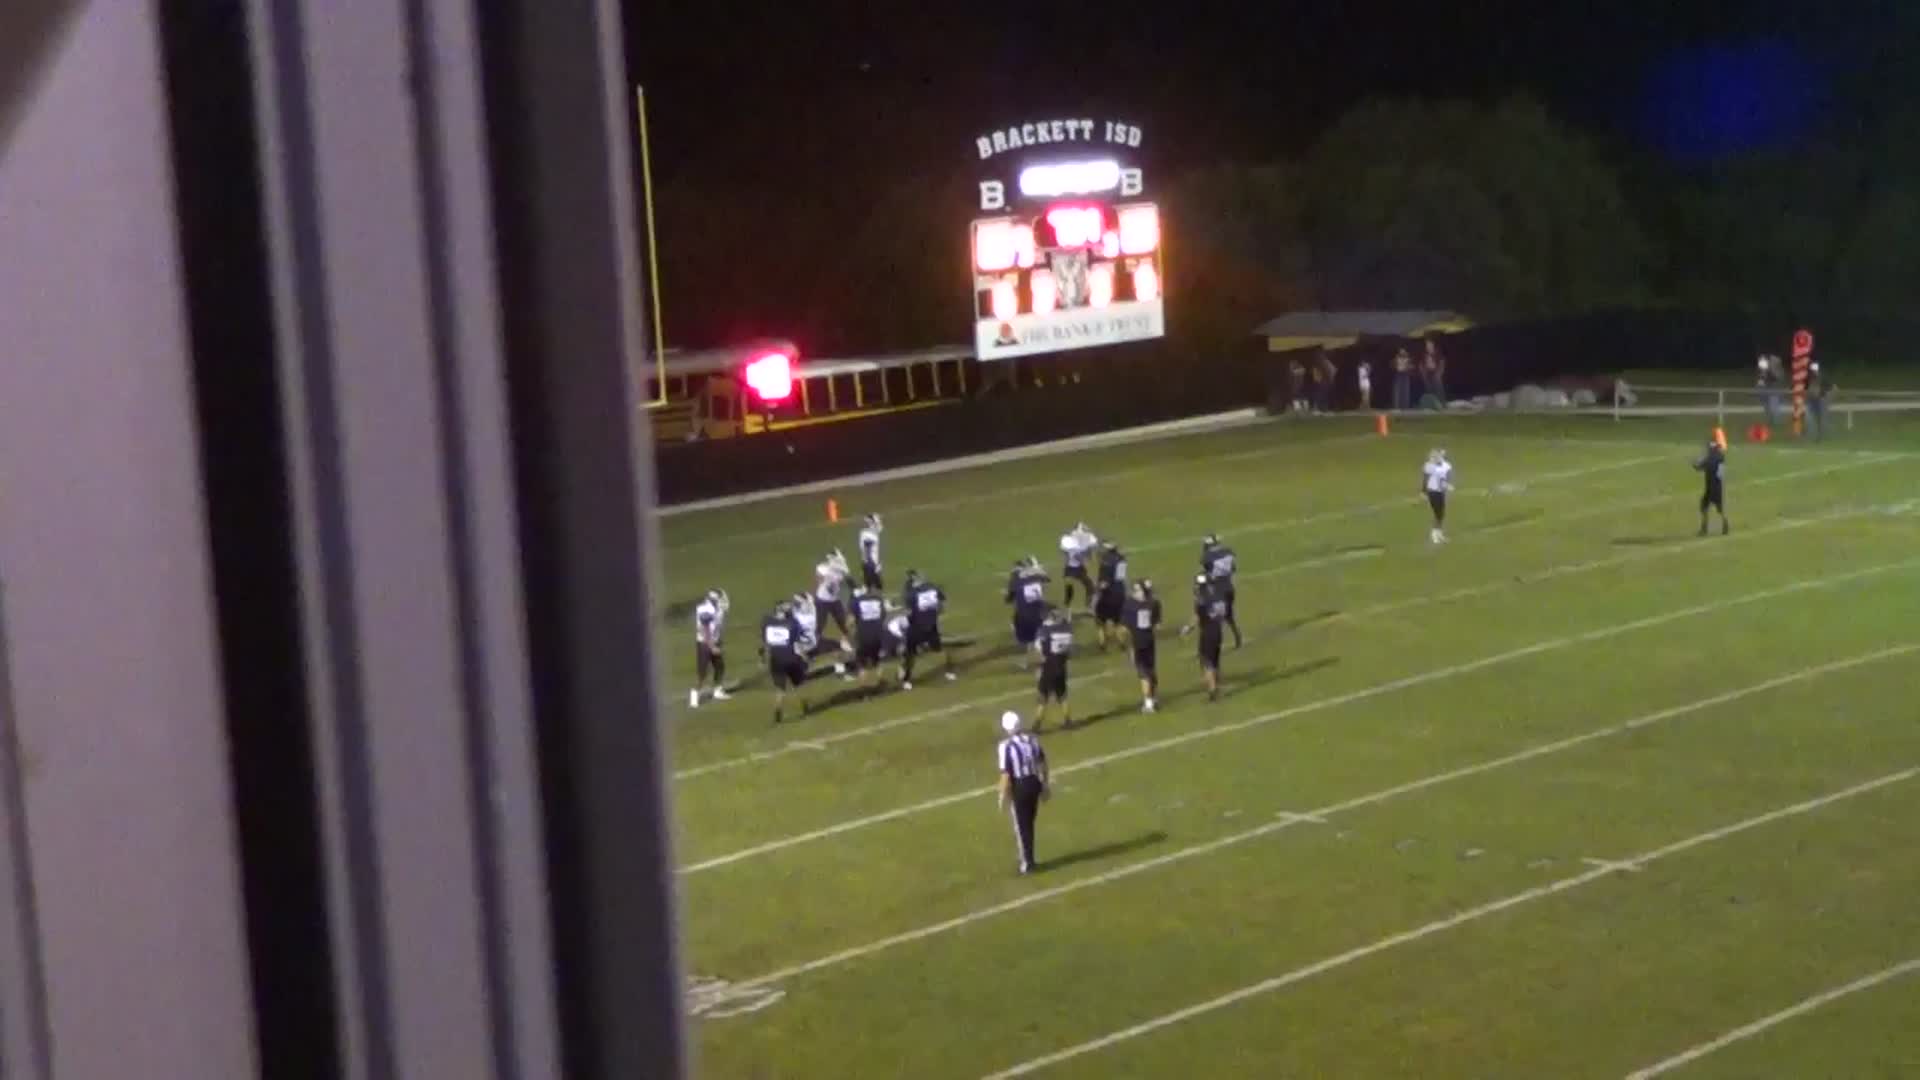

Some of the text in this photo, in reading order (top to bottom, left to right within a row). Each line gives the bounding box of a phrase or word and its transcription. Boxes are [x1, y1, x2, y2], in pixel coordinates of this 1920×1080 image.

[976, 119, 1142, 160] BRACKETT ISD
[979, 180, 1005, 210] B
[1121, 168, 1143, 196] B
